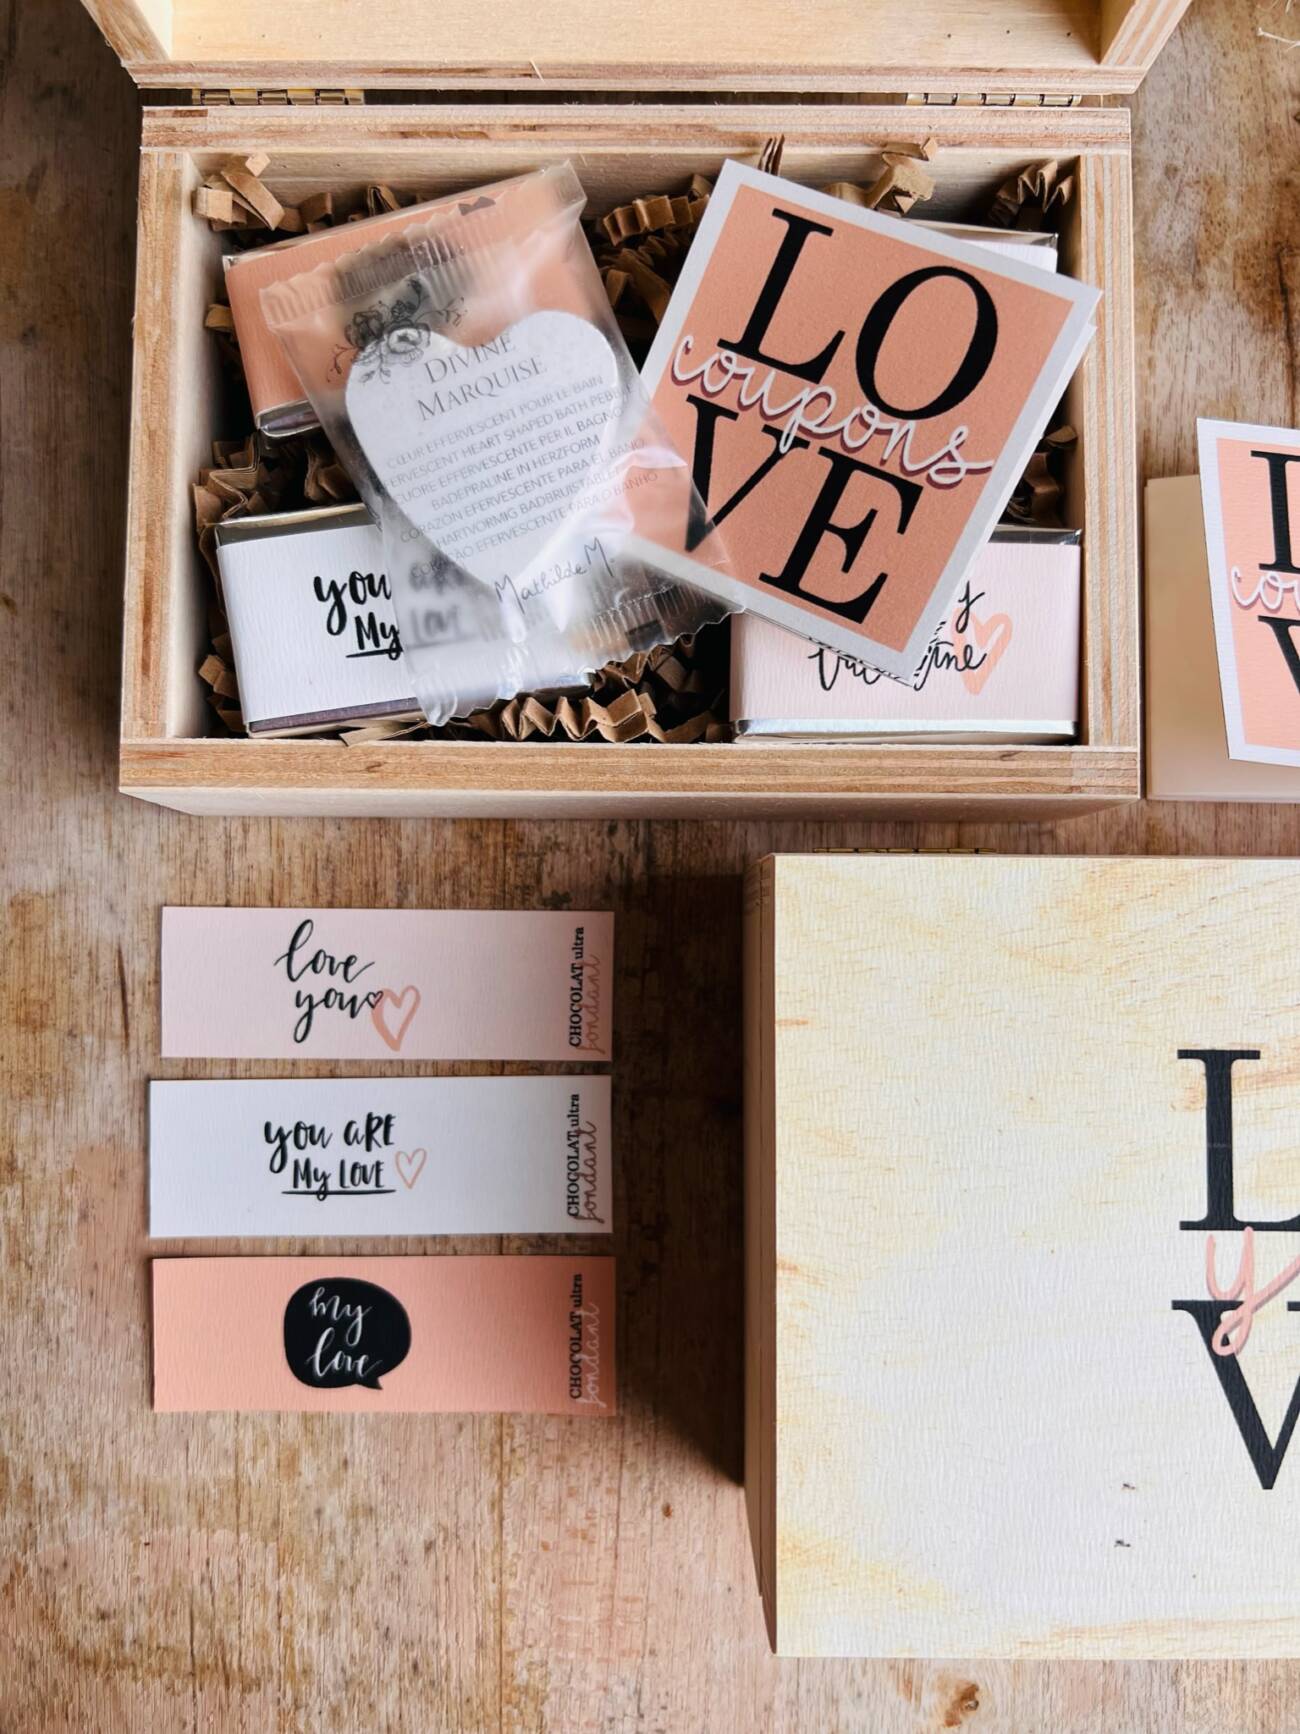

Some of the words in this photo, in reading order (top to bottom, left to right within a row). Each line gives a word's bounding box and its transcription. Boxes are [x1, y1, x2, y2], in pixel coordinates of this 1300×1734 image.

[424, 330, 516, 383] DIVINE
[416, 352, 548, 423] MARQUISE
[424, 407, 517, 454] EFFERVESCENT
[518, 392, 556, 416] POUR
[556, 387, 571, 401] LE
[572, 373, 604, 395] BAIN
[669, 334, 998, 490] coupons
[436, 438, 540, 489] EFFERVESCENTE
[538, 429, 562, 447] PER
[563, 424, 576, 437] IL
[575, 404, 625, 433] BAGNO
[460, 432, 502, 459] HEART
[502, 412, 554, 441] SHAPED
[554, 398, 589, 421] BATH
[429, 468, 515, 511] BADEPRALINE
[515, 460, 531, 476] IN
[530, 432, 600, 469] HERZFORM
[462, 470, 557, 518] EFERVESCENTE
[556, 456, 591, 479] PARA
[434, 505, 519, 548] HARTVORMIG
[474, 505, 569, 553] EFERVESCENTE
[313, 571, 391, 636] you
[495, 560, 588, 615] Mathilde
[354, 612, 403, 661] My
[274, 919, 375, 982] love
[575, 926, 585, 960] ultra
[295, 988, 373, 1043] you
[568, 962, 584, 1047] CHOCOLAT
[574, 954, 606, 1055] fondant
[569, 1094, 581, 1130] ultra
[263, 1119, 333, 1174] you
[566, 1131, 581, 1218] CHOCOLAT
[574, 1120, 605, 1224] fondant
[293, 1159, 331, 1201] My
[338, 1159, 385, 1189] LOVE
[309, 1286, 373, 1347] my
[570, 1273, 583, 1309] ultra
[304, 1326, 384, 1380] love
[569, 1311, 583, 1400] CHOCOLAT
[577, 1301, 607, 1409] fondant
